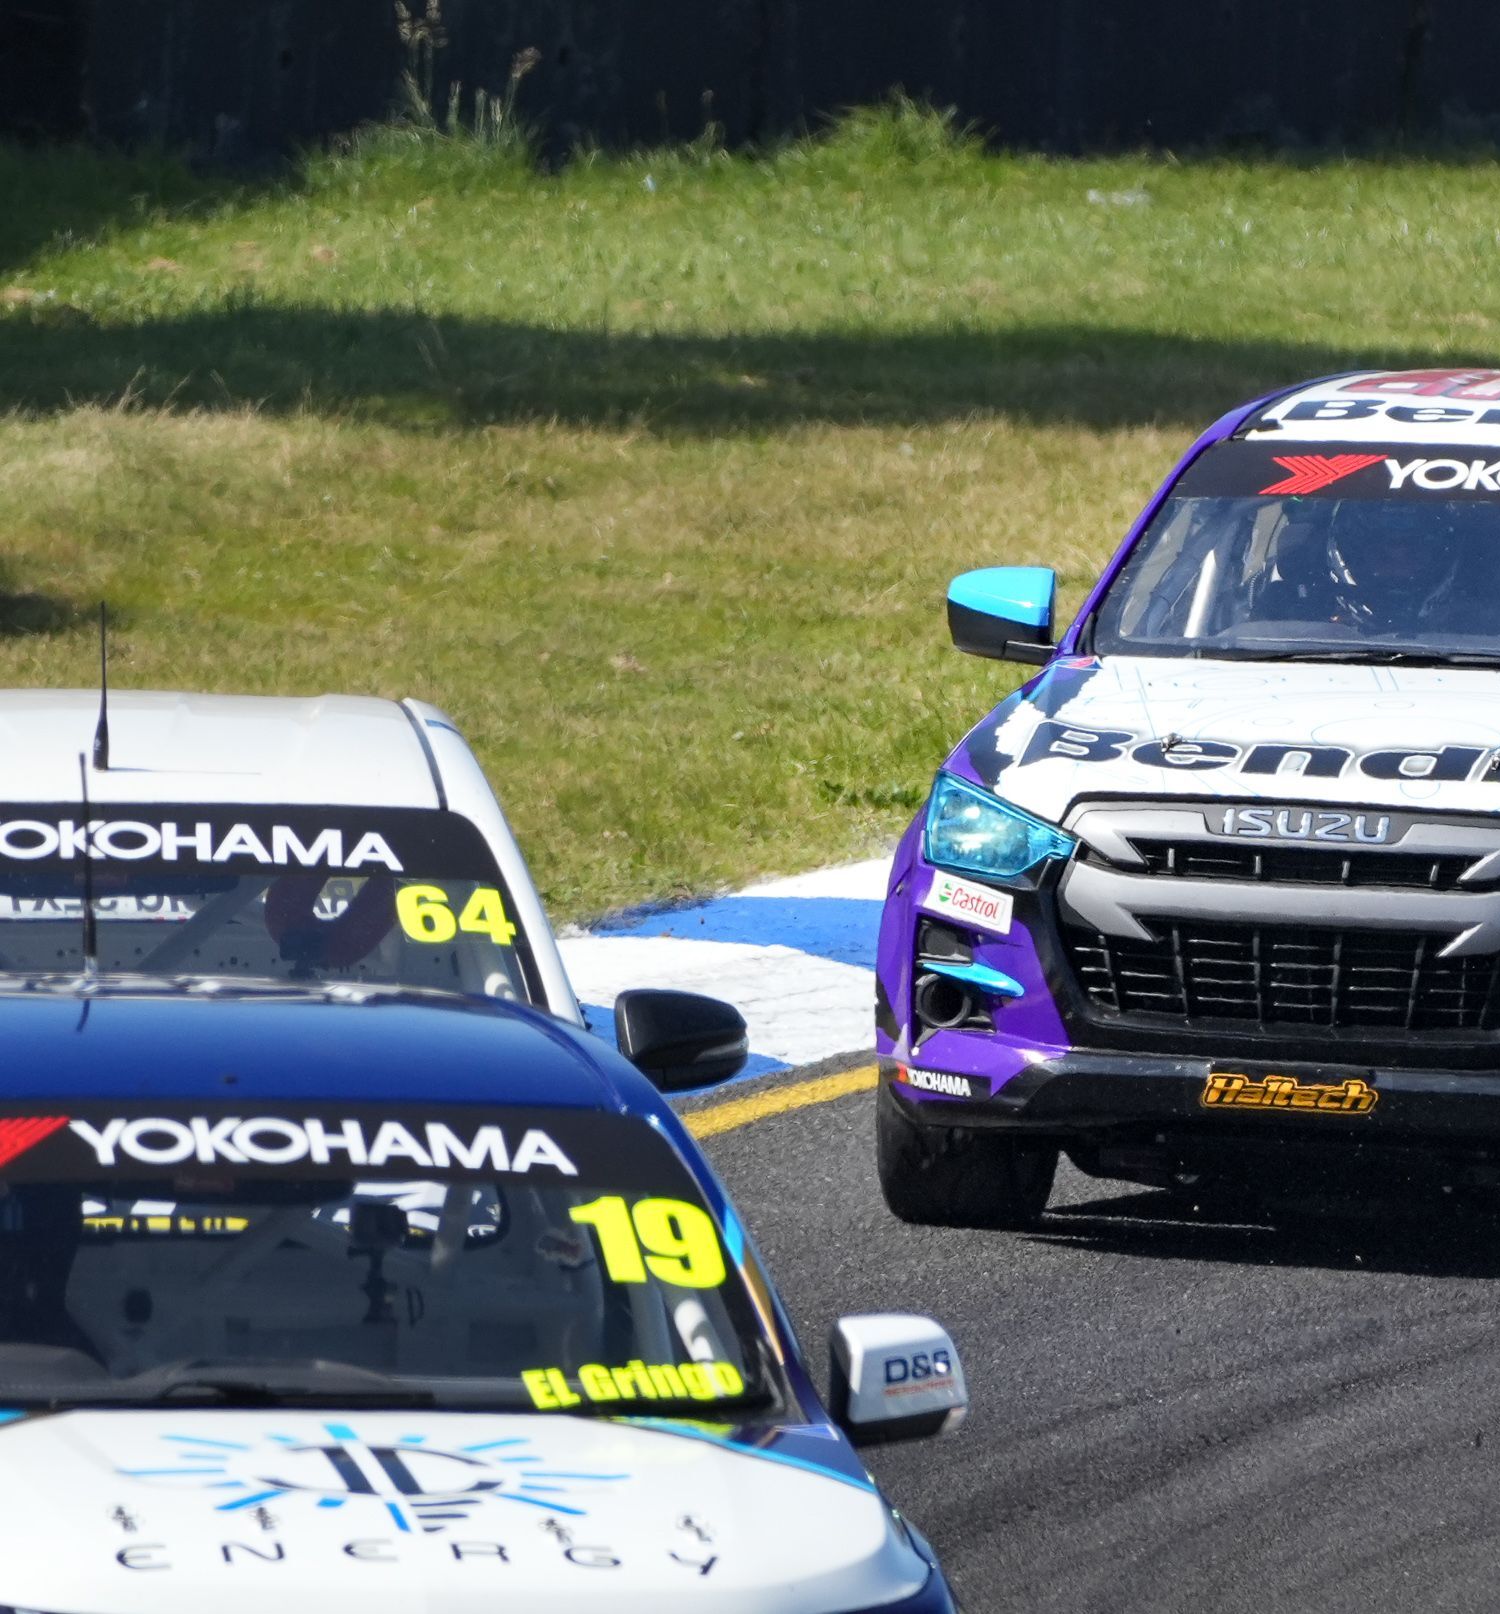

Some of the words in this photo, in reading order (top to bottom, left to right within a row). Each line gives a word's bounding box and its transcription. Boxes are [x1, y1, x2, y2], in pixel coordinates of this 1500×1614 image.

[0, 819, 405, 872] OKOHAMA
[1222, 806, 1391, 844] ISUZU
[396, 884, 517, 946] 64
[950, 886, 1001, 920] Castrol
[906, 1066, 972, 1098] YOKOHAMA
[1201, 1071, 1379, 1115] Haltech
[69, 1116, 579, 1176] YOKOHAMA
[568, 1195, 728, 1289] 19
[578, 1358, 745, 1402] Gringo
[116, 1539, 720, 1576] ENERGY
